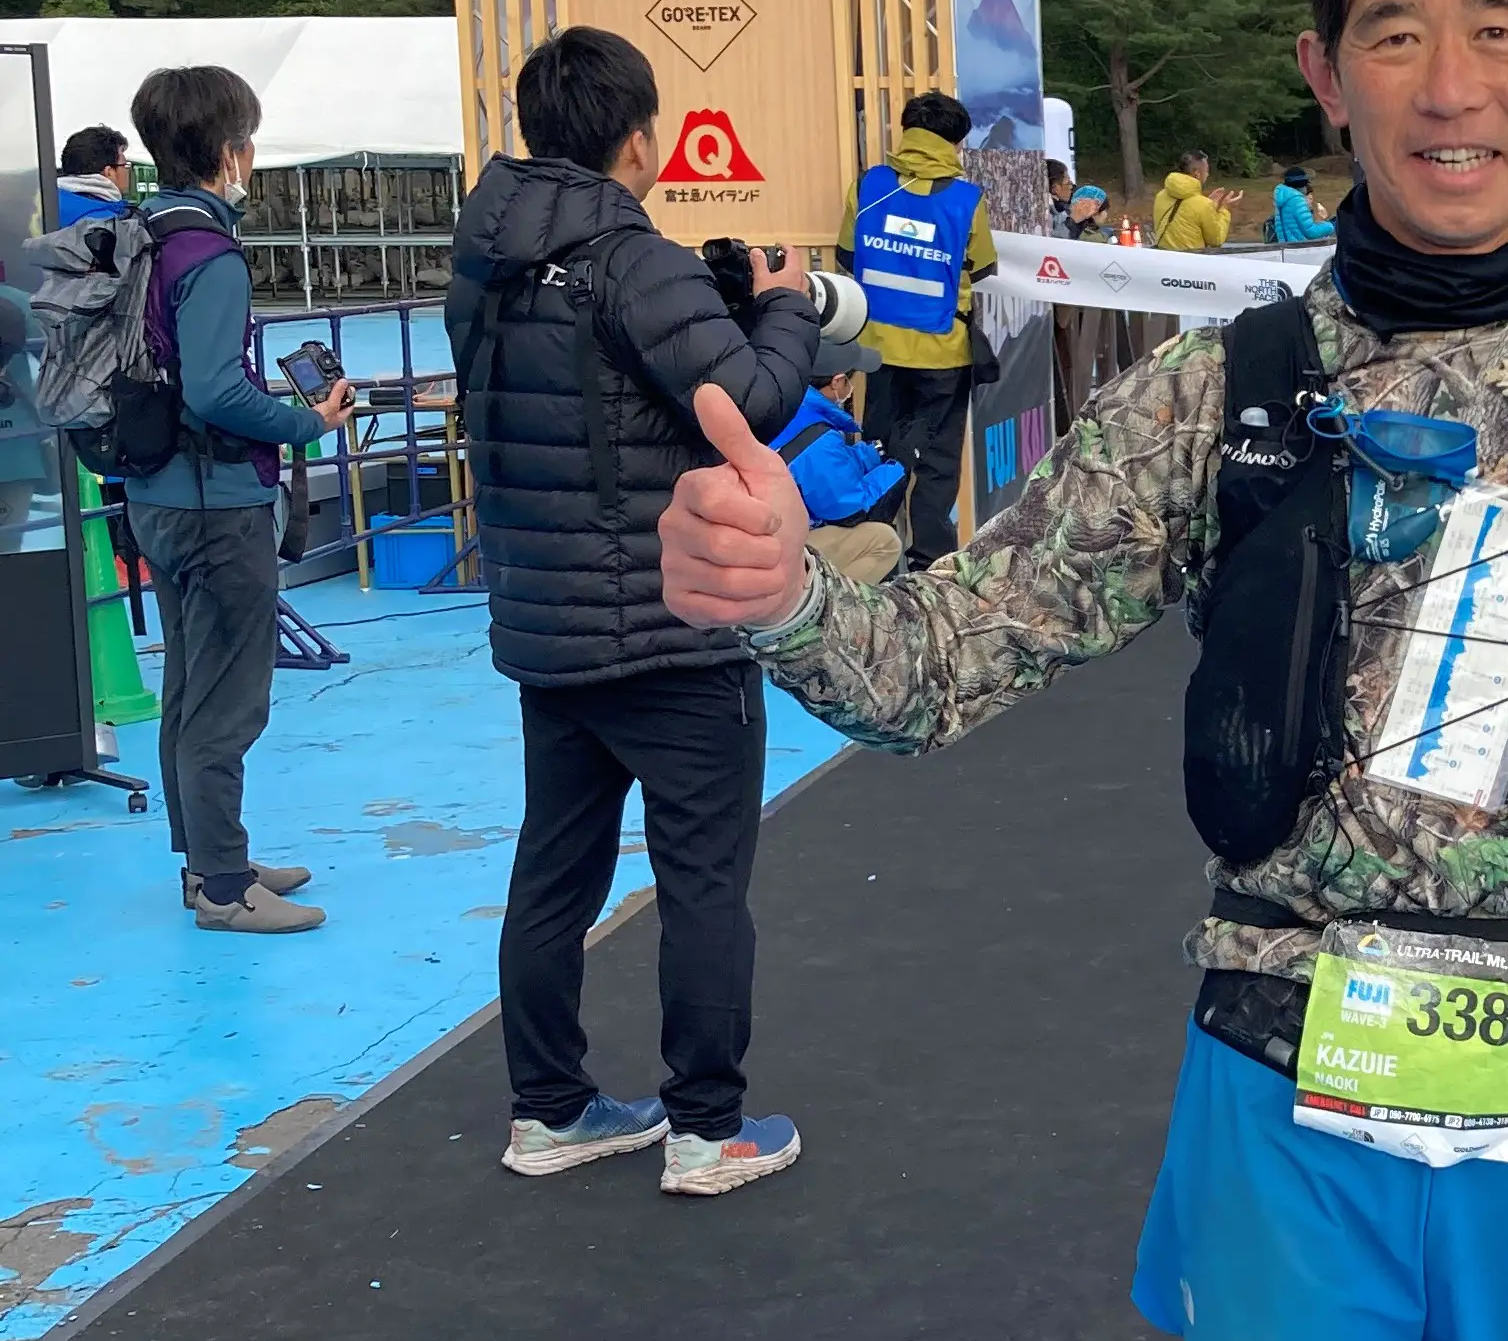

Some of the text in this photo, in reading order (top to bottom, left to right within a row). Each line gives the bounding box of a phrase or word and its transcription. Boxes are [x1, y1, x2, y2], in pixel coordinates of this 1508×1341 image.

[661, 6, 741, 22] GORE-TEX
[684, 123, 734, 179] Q
[664, 188, 761, 203] 富士急ハイランド
[862, 234, 953, 266] VOLUNTEER
[1244, 284, 1278, 294] NORTH
[1259, 278, 1278, 287] THE
[1397, 944, 1484, 965] ULTRA-TRAIL
[1346, 978, 1391, 1005] FUJI
[1341, 1010, 1388, 1029] WAVE-3
[1316, 1043, 1398, 1077] KAZUIE
[1314, 1071, 1359, 1092] NAOKI
